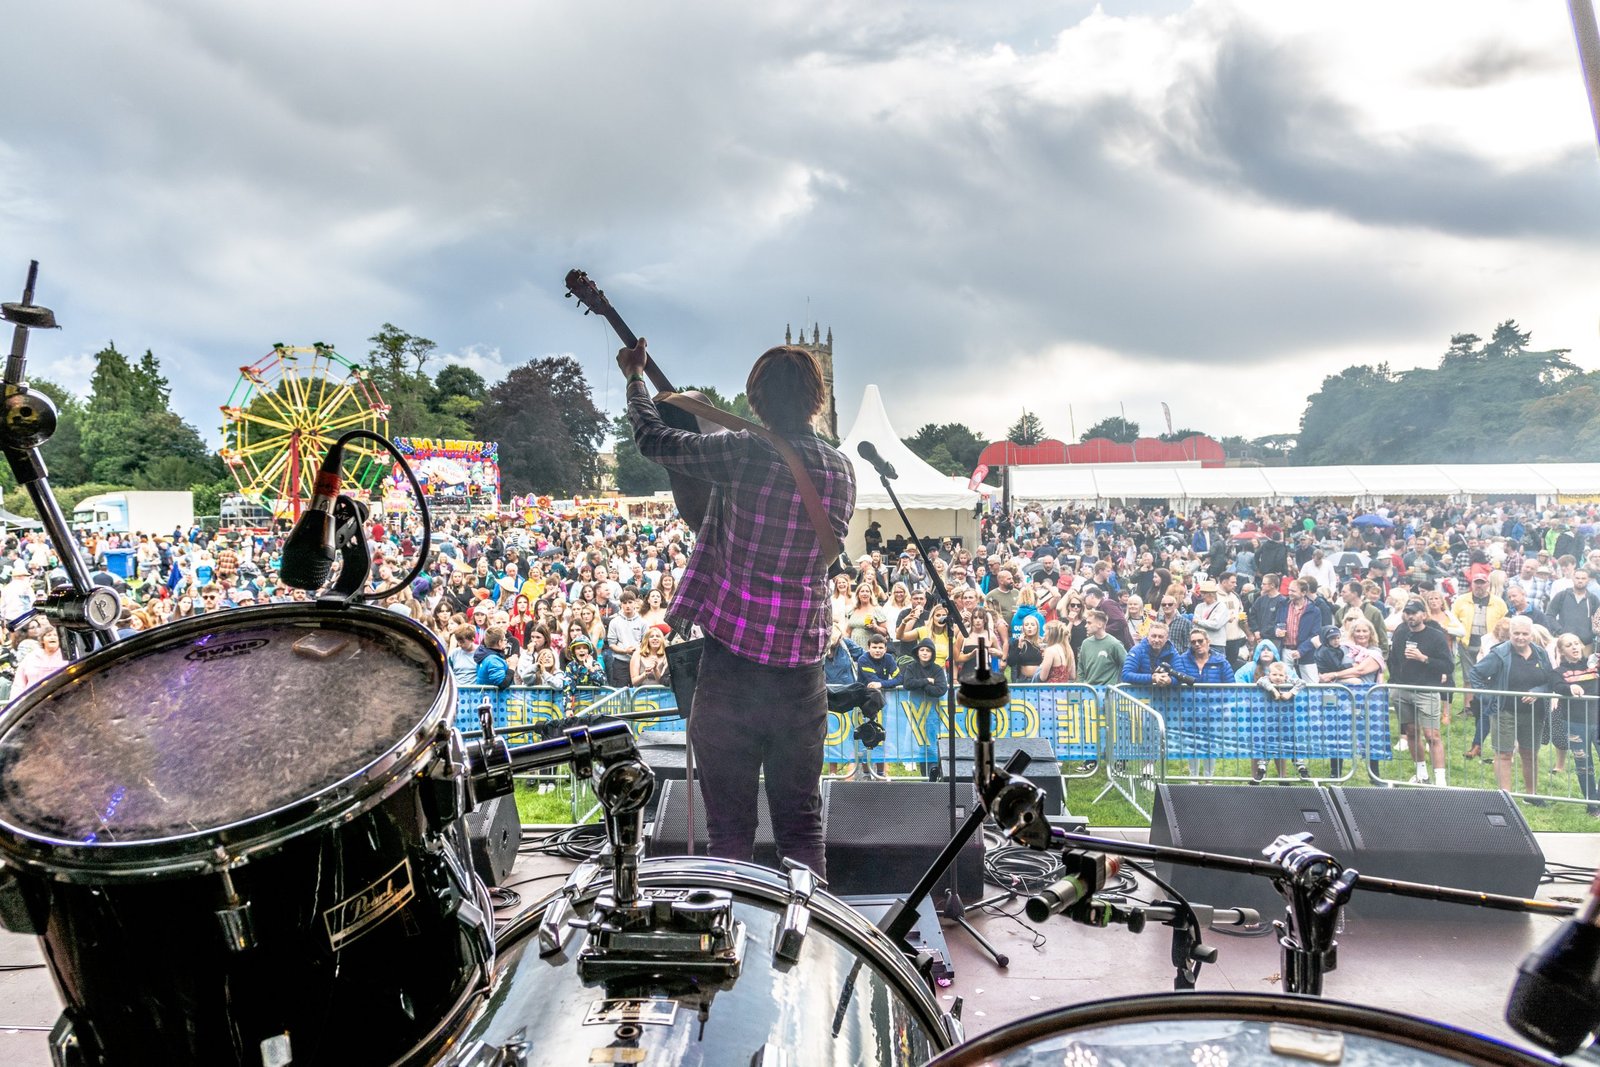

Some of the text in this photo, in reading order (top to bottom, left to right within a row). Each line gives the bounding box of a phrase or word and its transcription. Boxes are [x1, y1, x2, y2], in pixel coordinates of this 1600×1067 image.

[410, 437, 485, 453] NO LIMITS
[345, 878, 396, 926] Pearl
